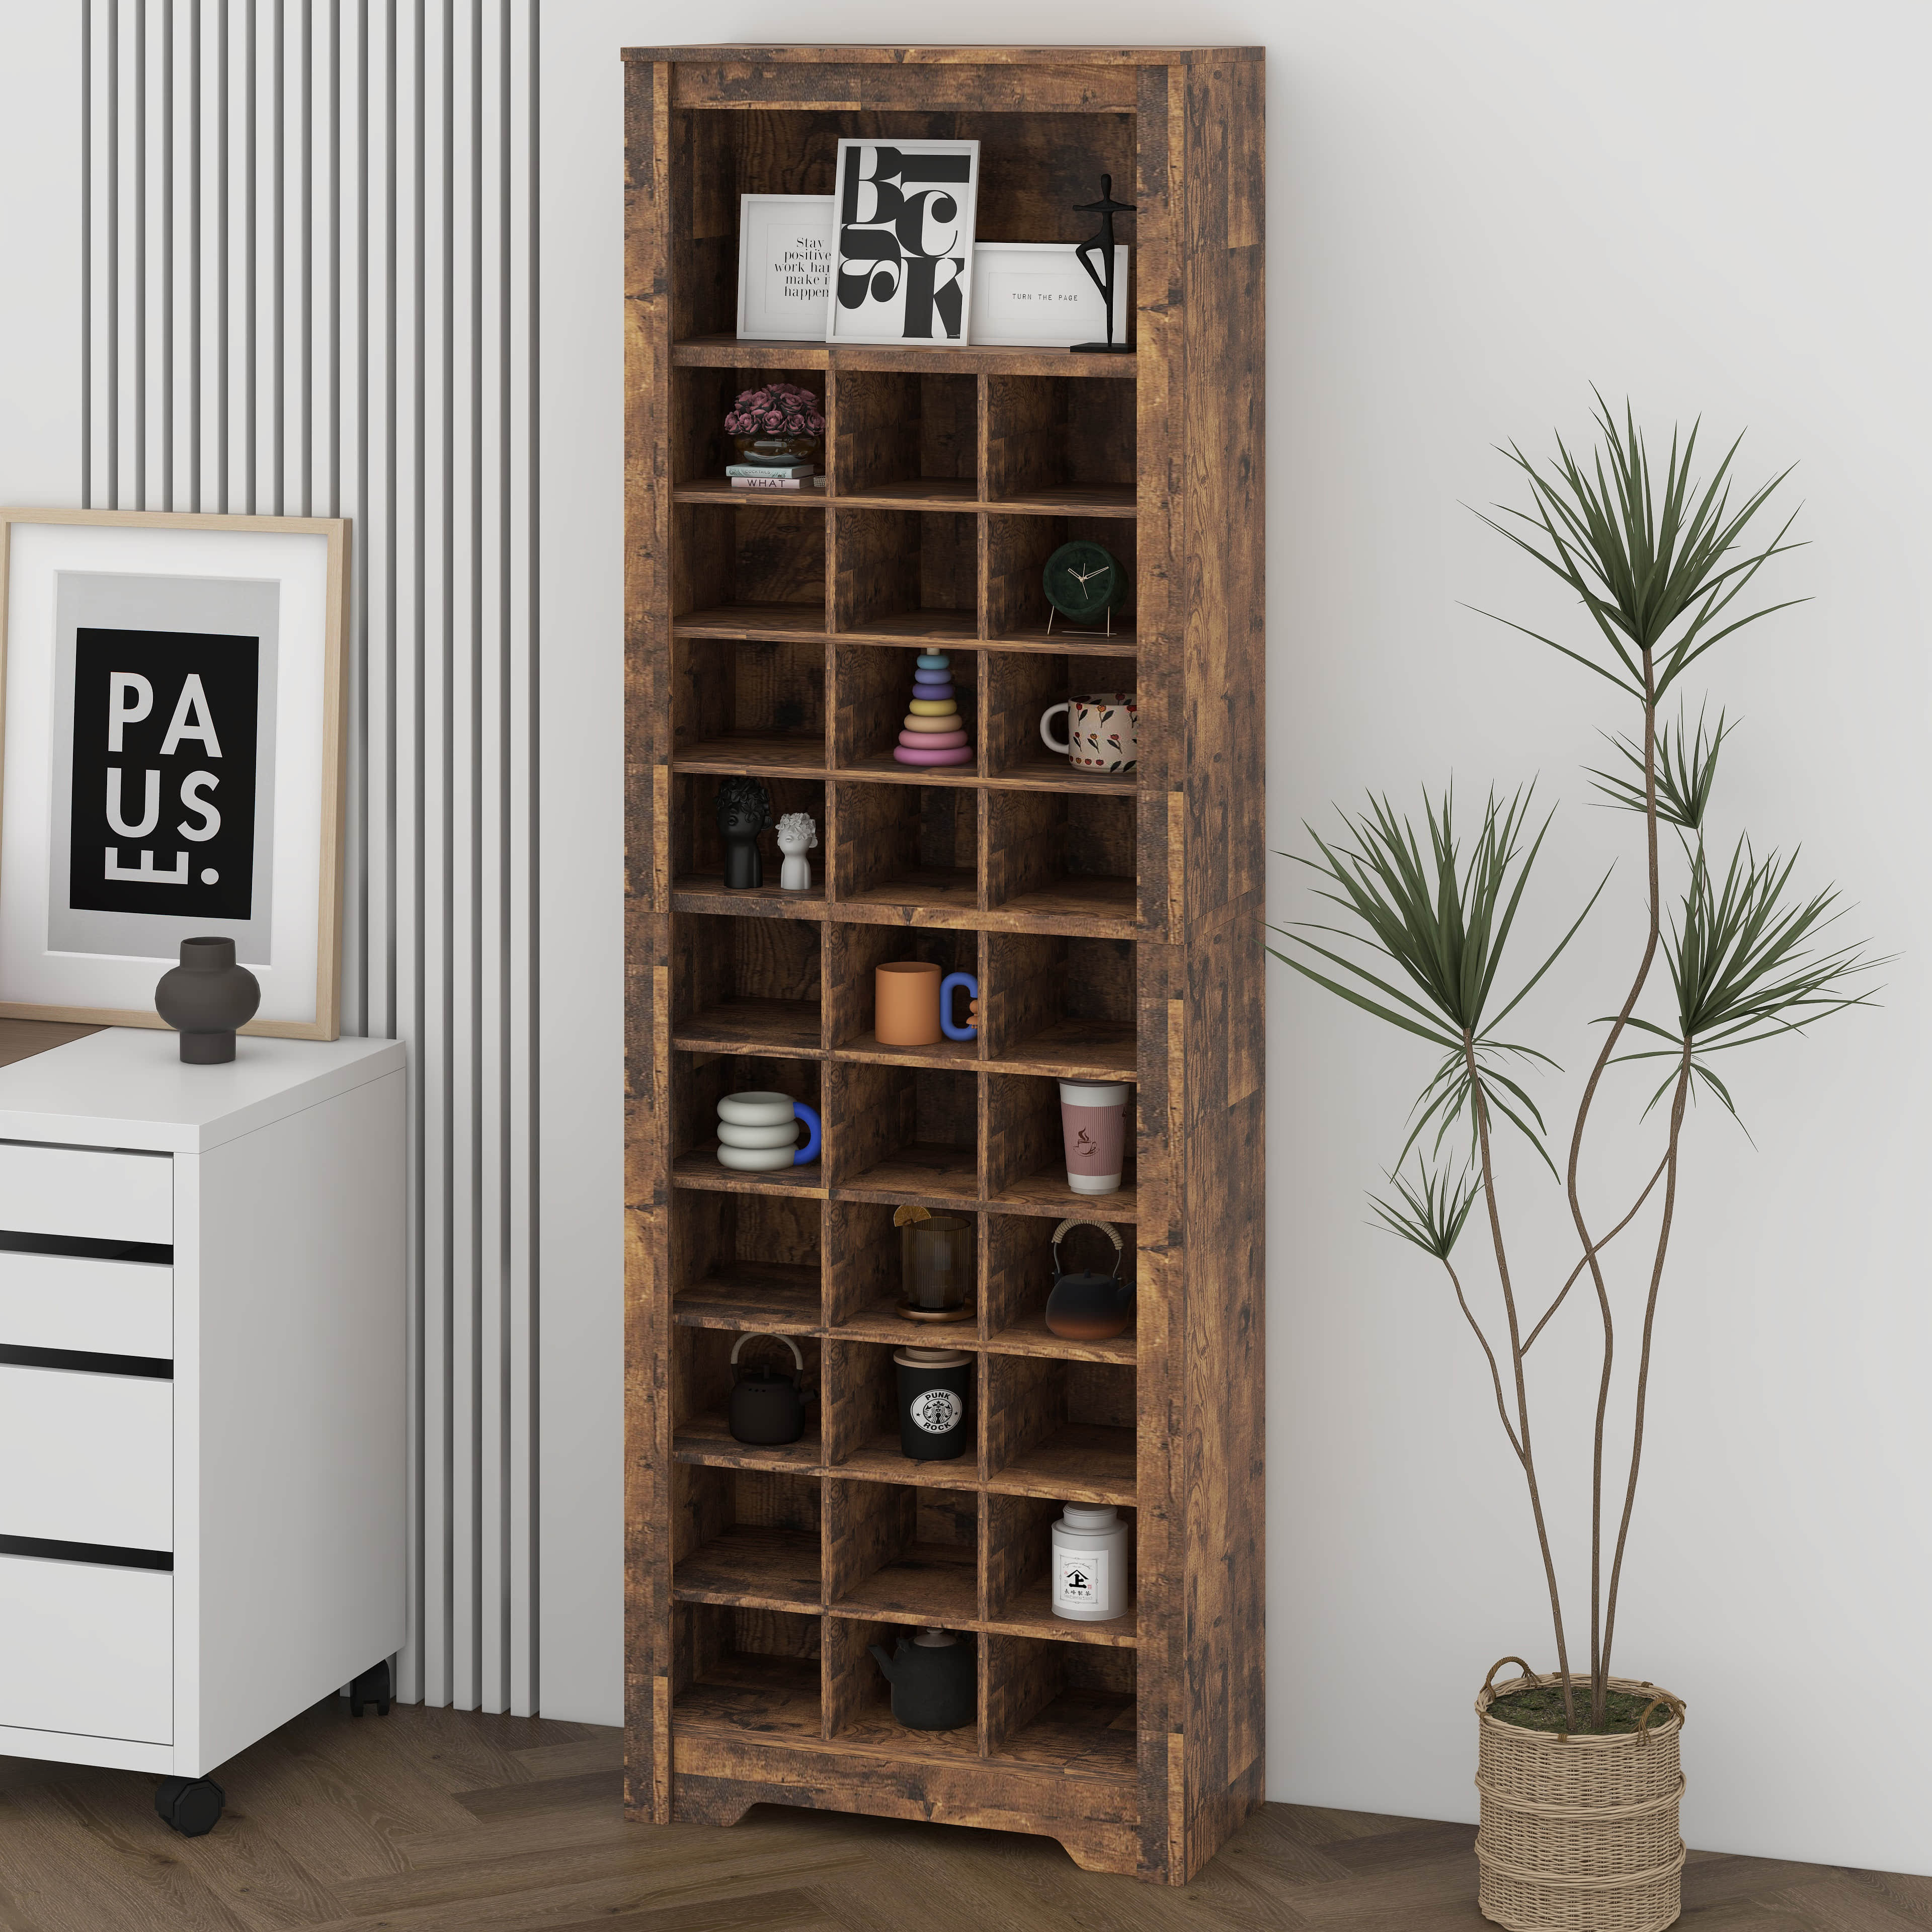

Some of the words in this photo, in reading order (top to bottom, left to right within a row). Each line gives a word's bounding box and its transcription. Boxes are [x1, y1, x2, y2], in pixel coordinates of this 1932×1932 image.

[796, 237, 824, 249] Stay
[784, 249, 832, 263] positive
[774, 261, 806, 273] work
[811, 262, 830, 273] har
[786, 274, 820, 285] make
[784, 286, 829, 300] happen
[747, 478, 785, 488] WHAT
[923, 1422, 951, 1430] ROCK
